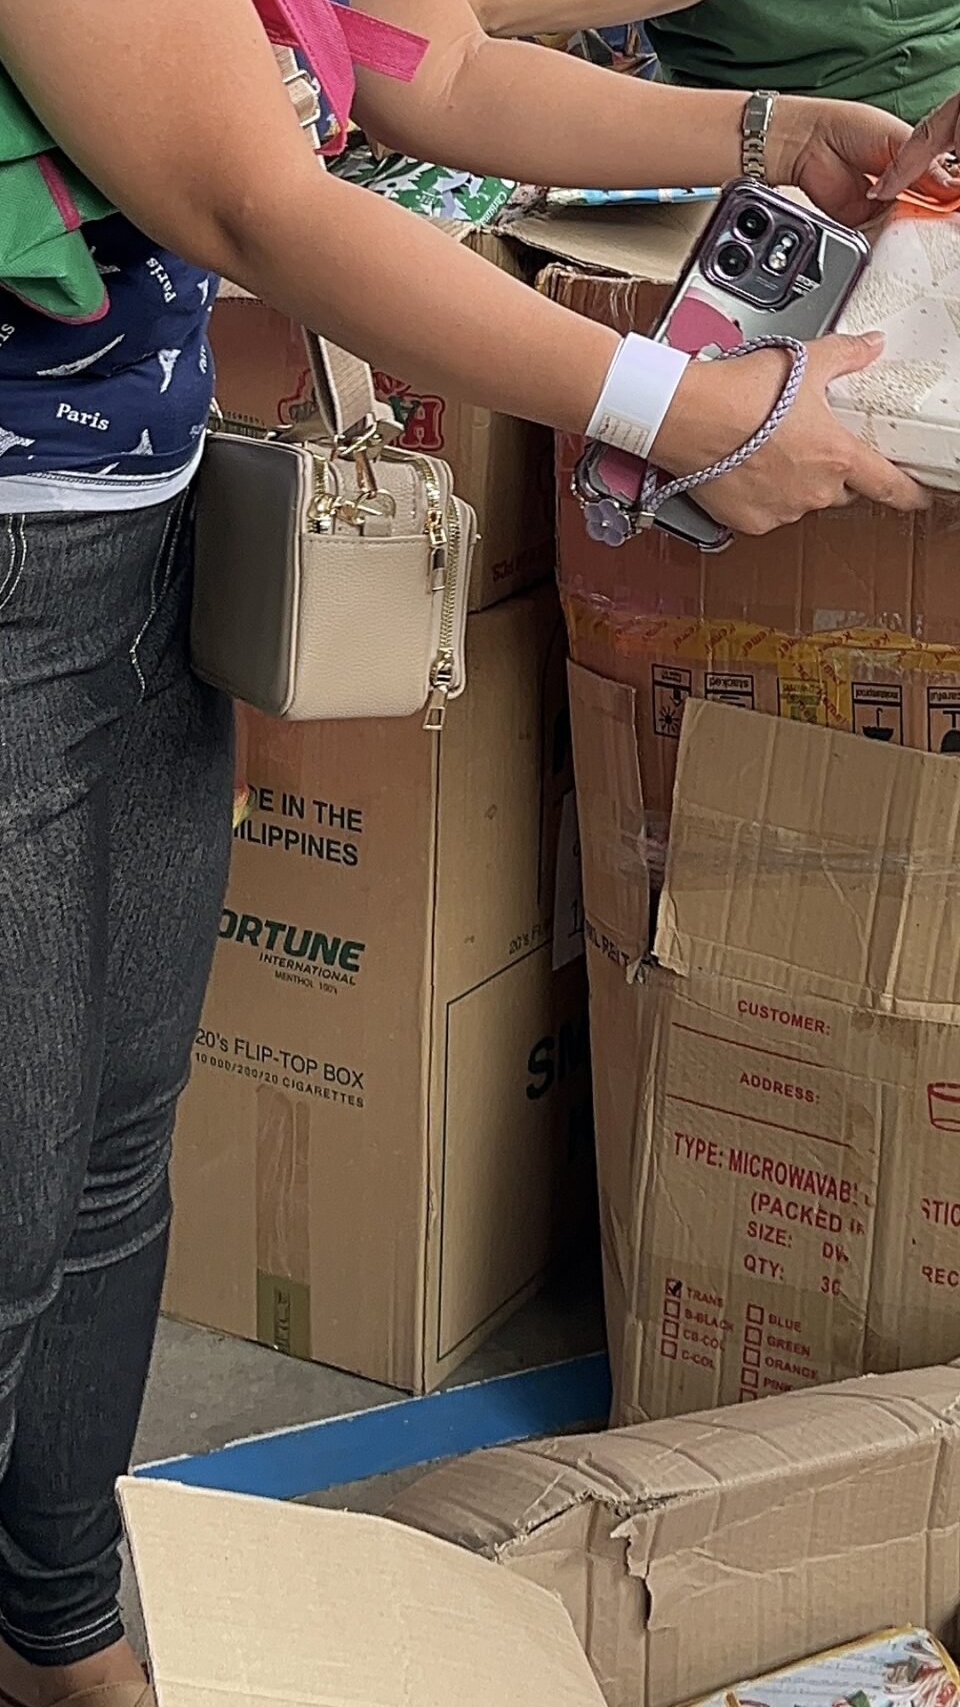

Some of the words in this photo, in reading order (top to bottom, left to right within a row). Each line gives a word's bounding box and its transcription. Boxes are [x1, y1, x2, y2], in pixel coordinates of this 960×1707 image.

[146, 256, 177, 304] Paris
[56, 403, 110, 431] Paris
[282, 792, 305, 820] IN
[312, 799, 363, 834] THE
[259, 952, 357, 987] INTERNATIONAL
[275, 970, 314, 989] MENTHOL
[737, 999, 832, 1036] CUSTOMER:
[195, 1028, 229, 1053] 20's
[234, 1037, 318, 1076] FLIP-TOP
[323, 1063, 364, 1090] BOX
[282, 1076, 364, 1109] CIGARETTES
[739, 1071, 821, 1105] ADDRESS:
[674, 1132, 724, 1169] TYPE:
[750, 1191, 842, 1233] (PACKED
[746, 1220, 793, 1249] SIZE:
[743, 1254, 785, 1281] QTY:
[686, 1286, 724, 1309] TRANS
[768, 1312, 802, 1333] BLUE
[766, 1334, 811, 1358] GREEN
[764, 1356, 818, 1380] ORANGE
